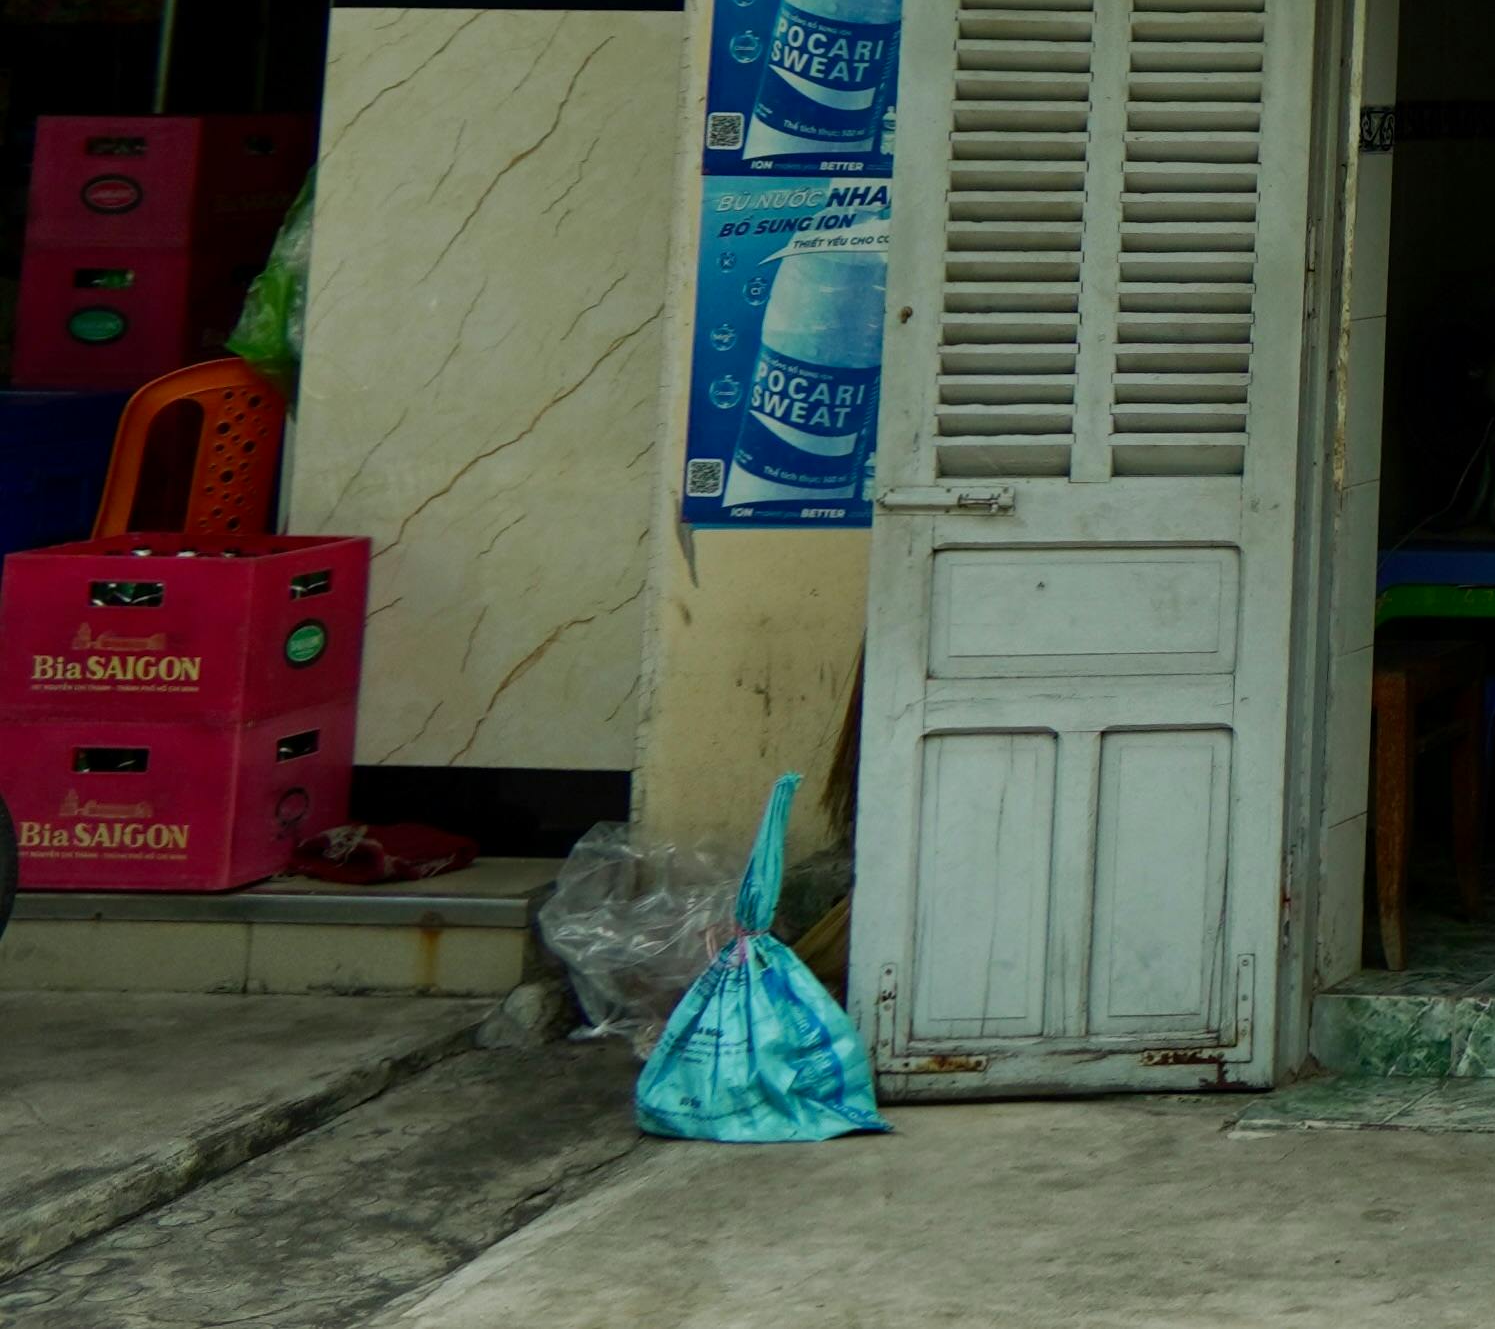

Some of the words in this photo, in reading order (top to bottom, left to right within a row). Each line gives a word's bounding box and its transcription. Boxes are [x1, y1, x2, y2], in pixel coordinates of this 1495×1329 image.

[775, 18, 884, 61] POCARI
[771, 42, 870, 83] SWEAT
[751, 161, 773, 170] ION
[819, 161, 864, 171] BETTER
[754, 217, 814, 235] SUNG
[816, 214, 857, 230] ION
[850, 236, 874, 245] CHO
[755, 360, 866, 407] POCARI
[751, 385, 851, 428] SWEAT
[730, 508, 752, 518] ION
[800, 508, 845, 518] BETTER
[31, 655, 82, 680] Bia
[86, 655, 202, 681] SAIGON
[18, 821, 70, 847] Bia
[73, 822, 190, 849] SAIGON
